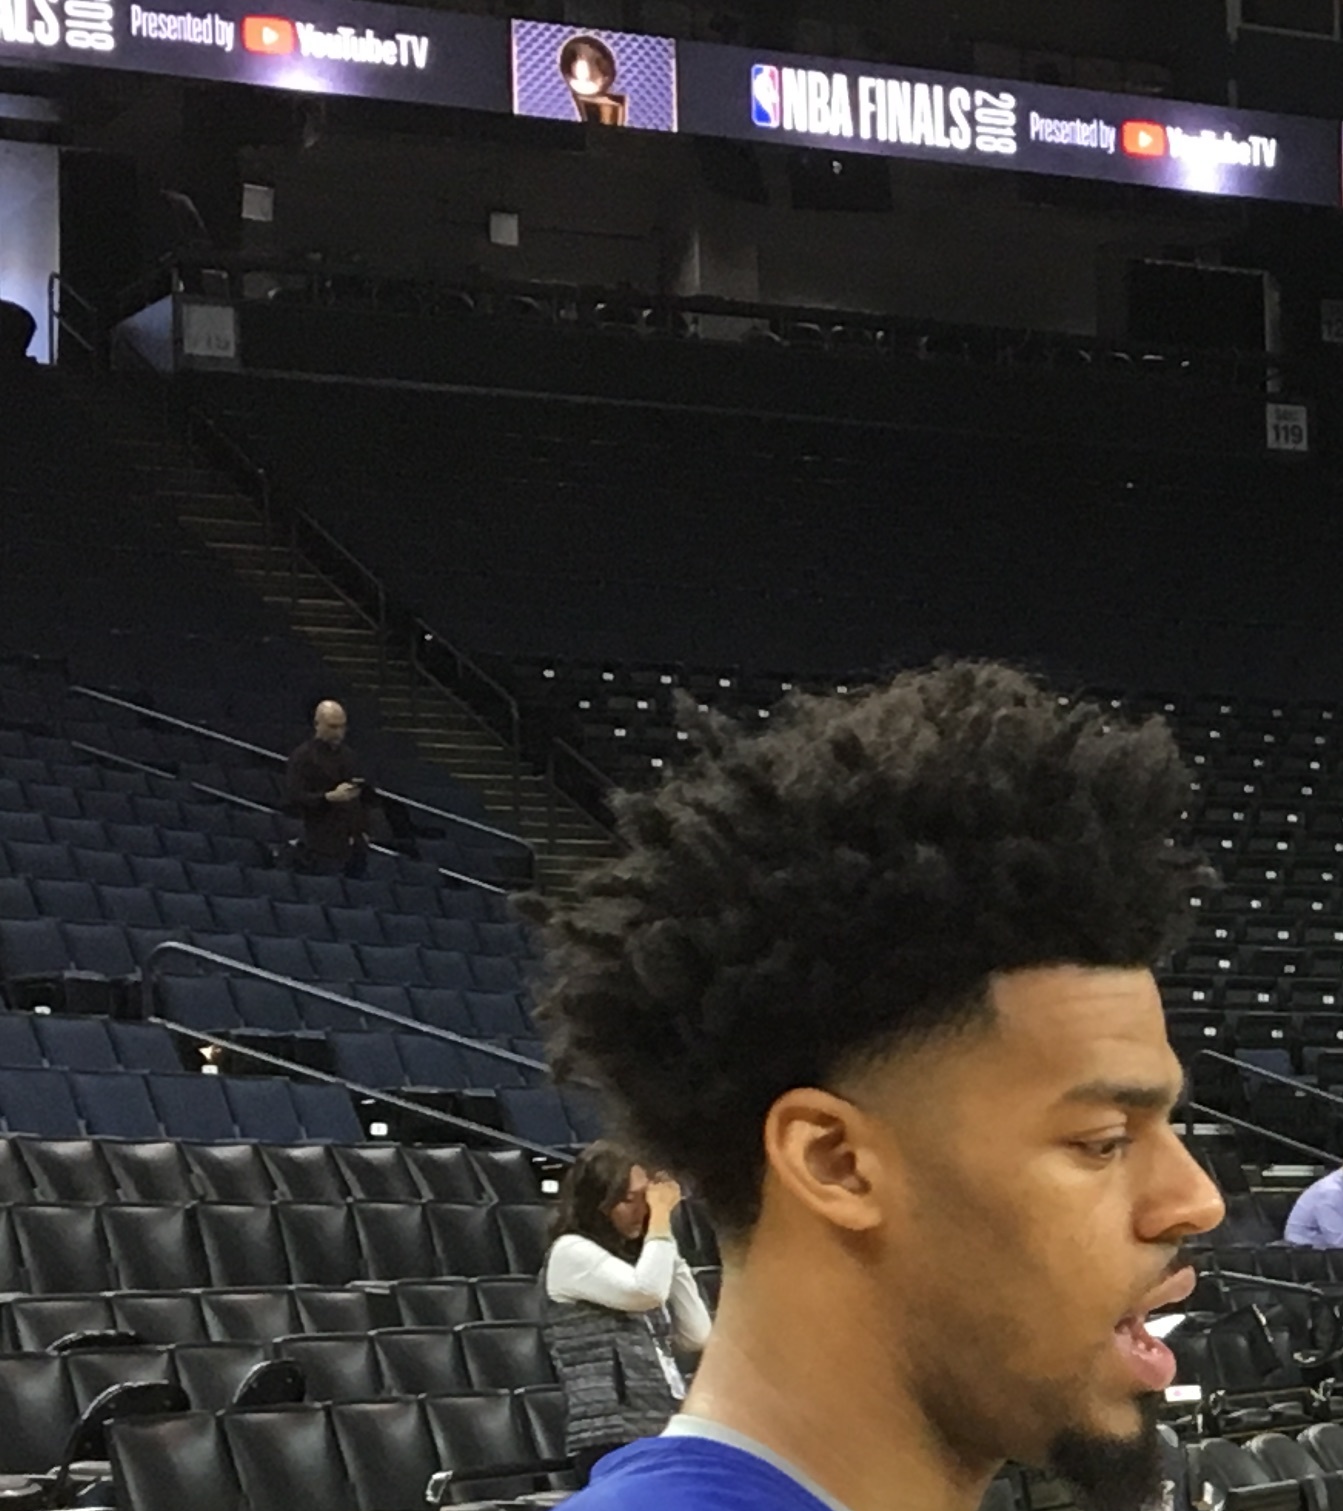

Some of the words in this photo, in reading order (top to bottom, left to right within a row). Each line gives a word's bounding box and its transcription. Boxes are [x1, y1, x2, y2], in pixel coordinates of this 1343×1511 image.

[63, 0, 115, 50] 018
[130, 4, 210, 44] Presented
[214, 14, 236, 52] by
[781, 67, 854, 138] NBA
[857, 75, 972, 151] FINALS
[973, 89, 1018, 155] 2018
[1029, 111, 1097, 148] Presented
[1099, 120, 1116, 154] by
[1272, 424, 1304, 445] 119
